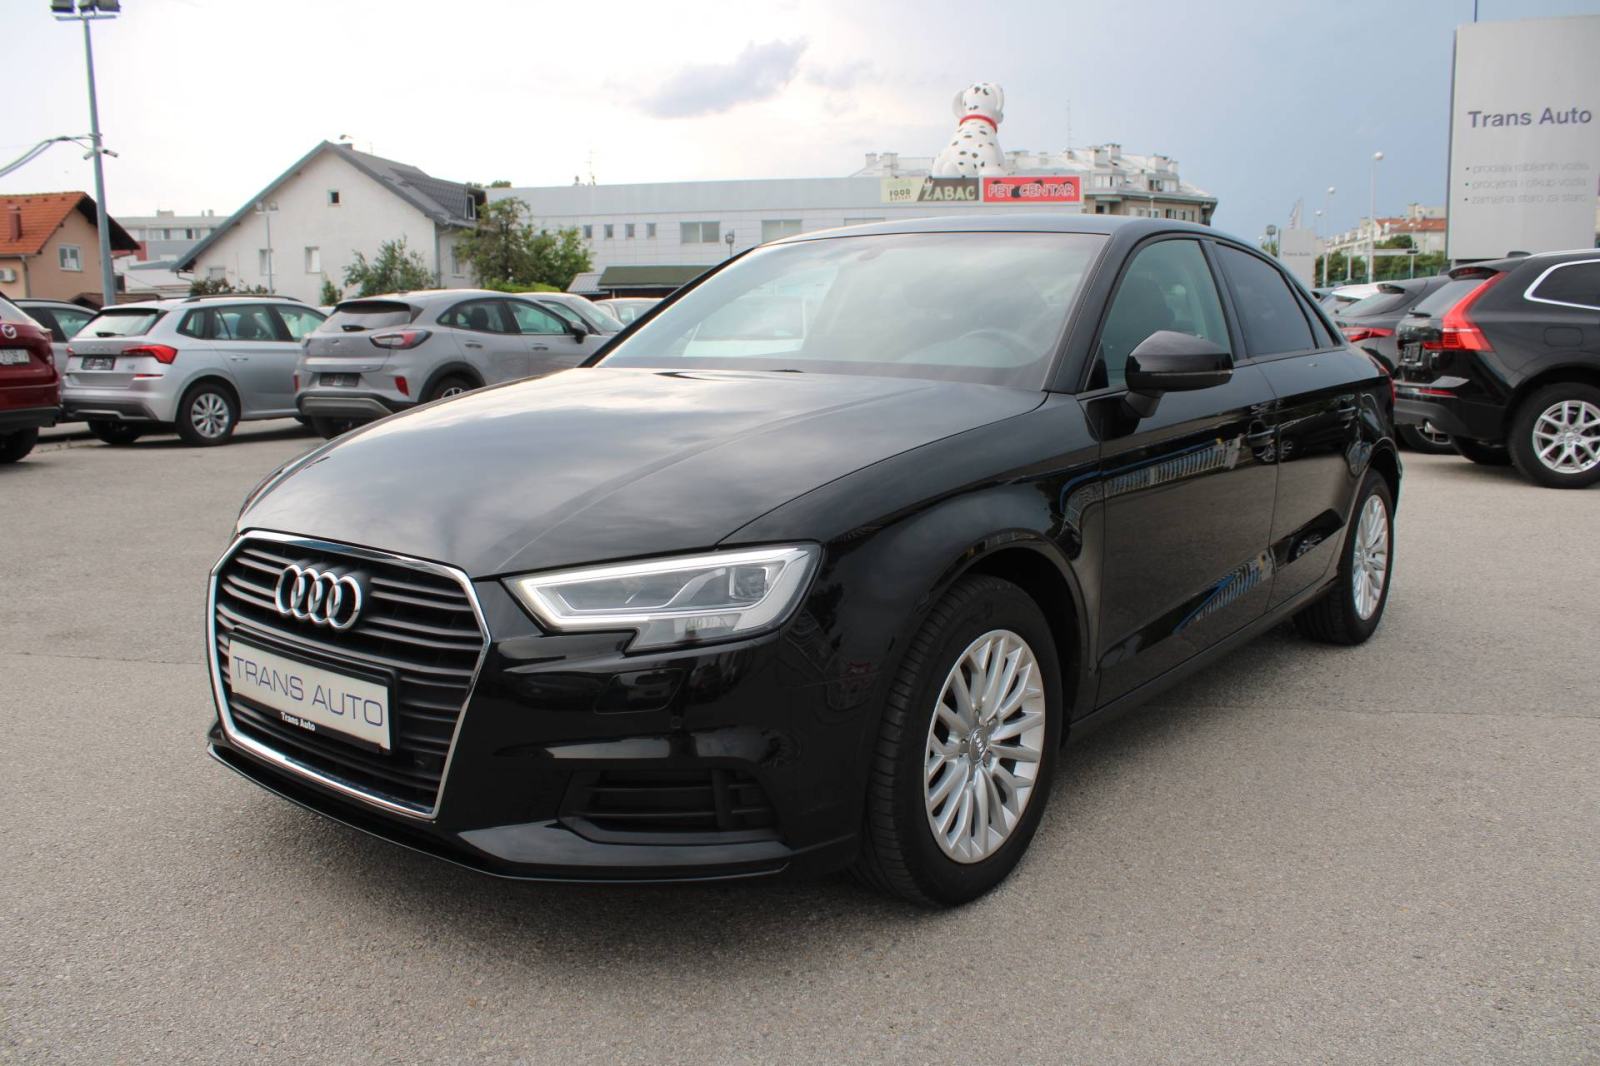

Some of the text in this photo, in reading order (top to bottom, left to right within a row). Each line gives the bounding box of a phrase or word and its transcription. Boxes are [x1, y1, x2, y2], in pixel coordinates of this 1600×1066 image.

[1467, 107, 1592, 128] Trans Auto
[987, 182, 1075, 198] PET CENTAR
[233, 655, 383, 727] TRANS AUTO
